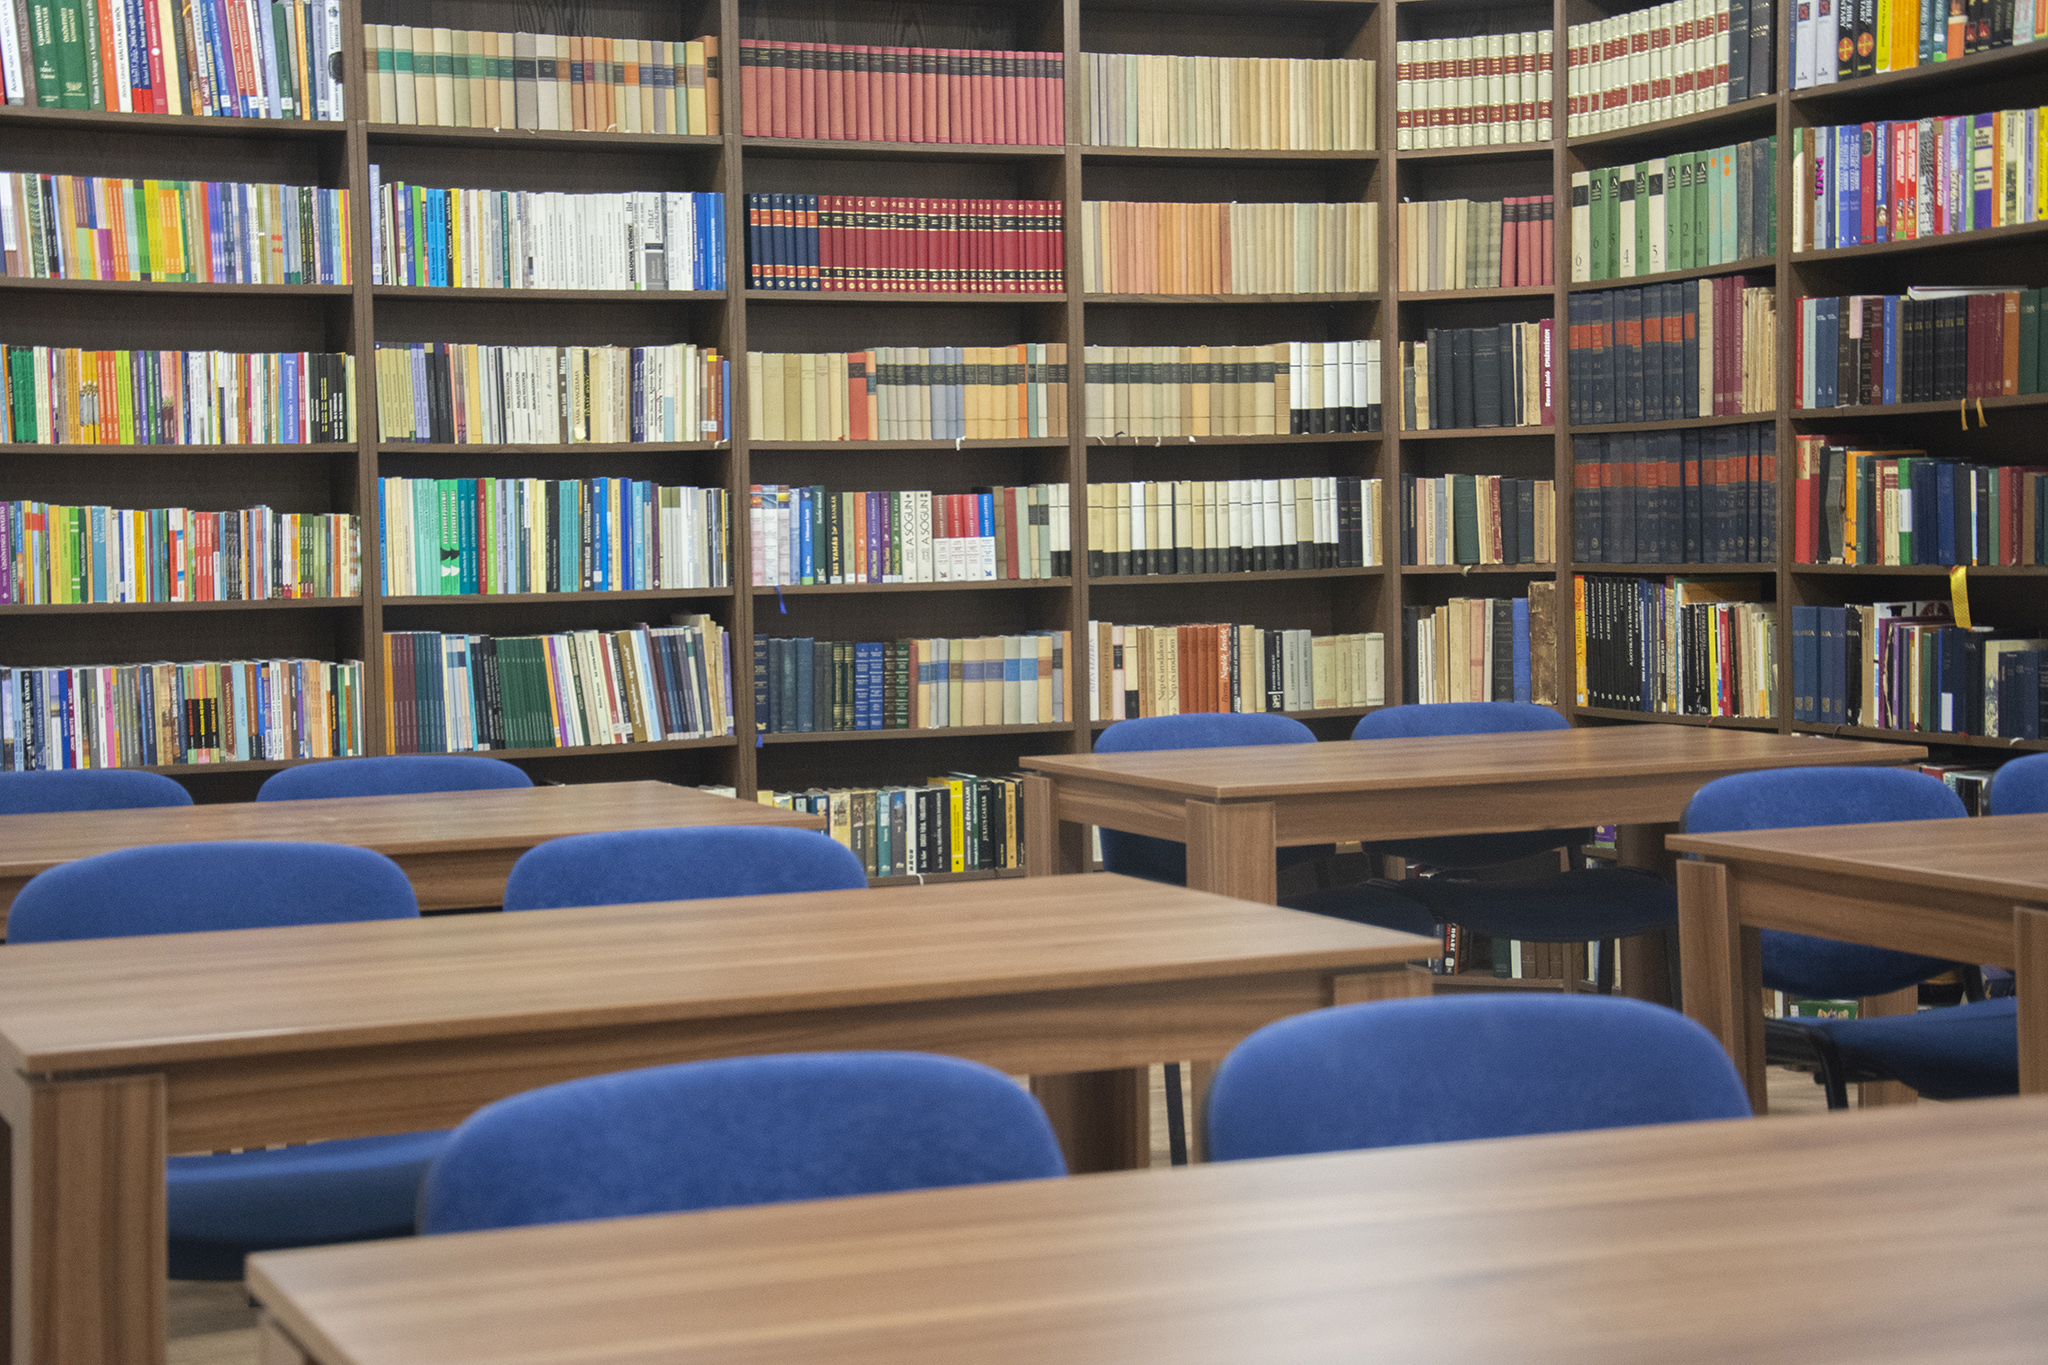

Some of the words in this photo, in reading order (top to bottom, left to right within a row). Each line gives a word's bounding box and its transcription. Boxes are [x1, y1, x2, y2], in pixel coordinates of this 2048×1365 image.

[1815, 157, 1825, 197] PAUL
[903, 500, 914, 536] SÓGUN
[919, 500, 929, 535] SÓGUN
[906, 537, 914, 546] A
[922, 537, 929, 545] A
[1220, 628, 1229, 651] levelek
[1156, 639, 1165, 673] irodalom
[1167, 639, 1176, 673] irodalom
[1158, 684, 1167, 700] Nép
[1168, 684, 1177, 700] Nép
[965, 811, 971, 820] ÉN
[966, 821, 971, 831] AZ
